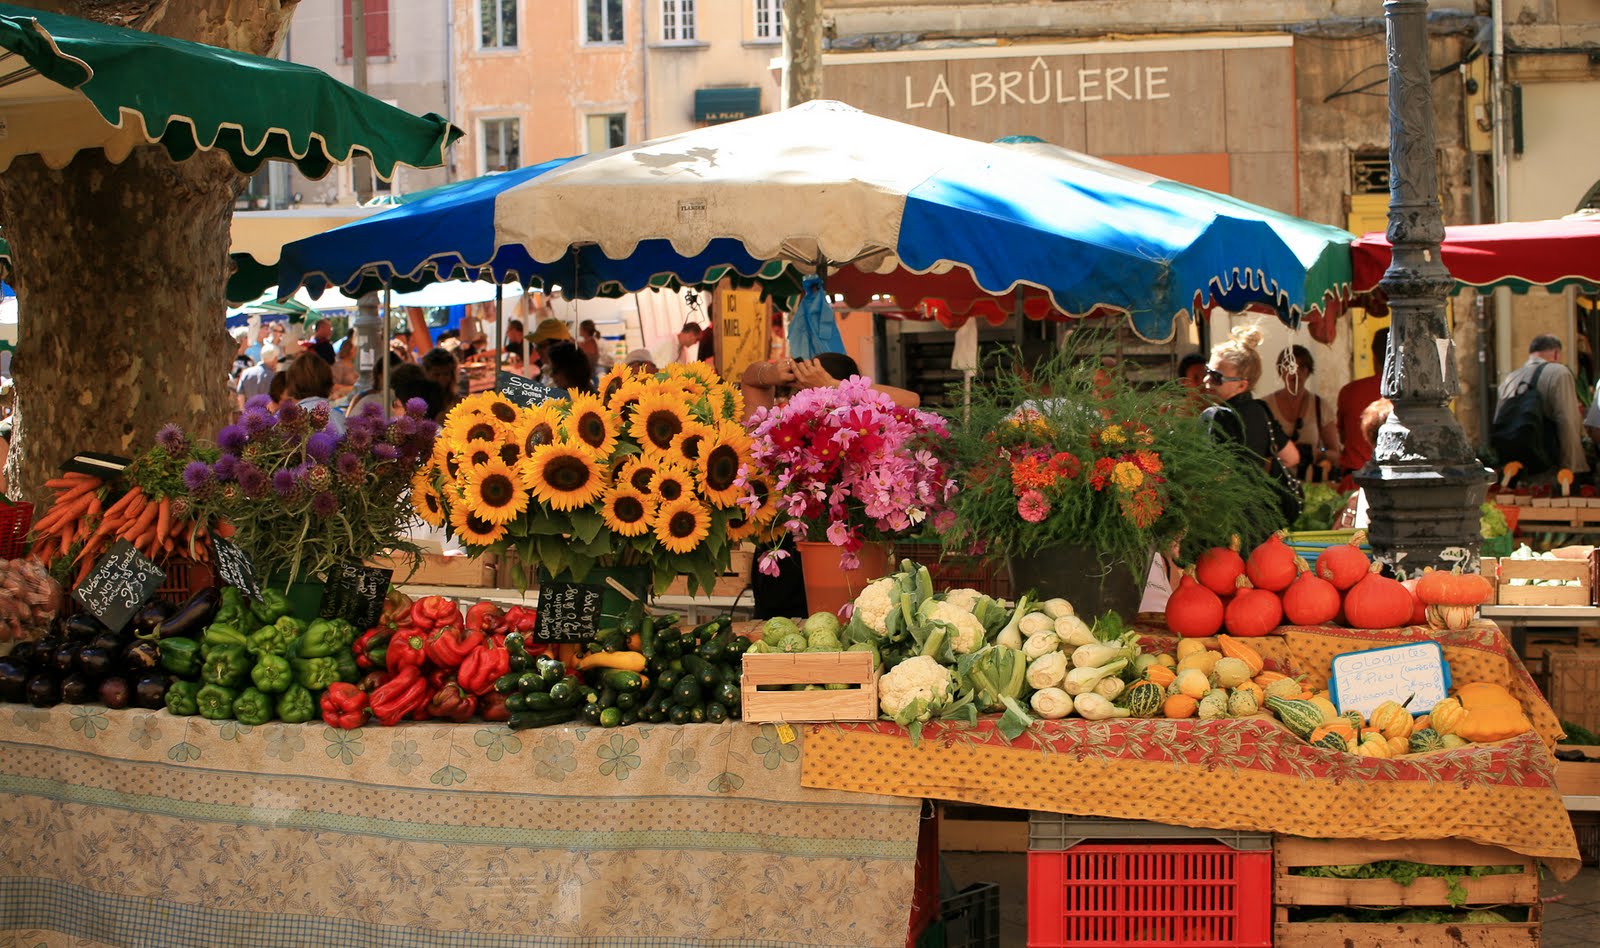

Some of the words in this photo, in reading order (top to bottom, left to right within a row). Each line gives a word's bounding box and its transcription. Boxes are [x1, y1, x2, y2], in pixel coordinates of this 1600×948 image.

[905, 74, 955, 109] LA
[970, 56, 1170, 107] BRÛLERIE
[724, 319, 740, 336] MIEL
